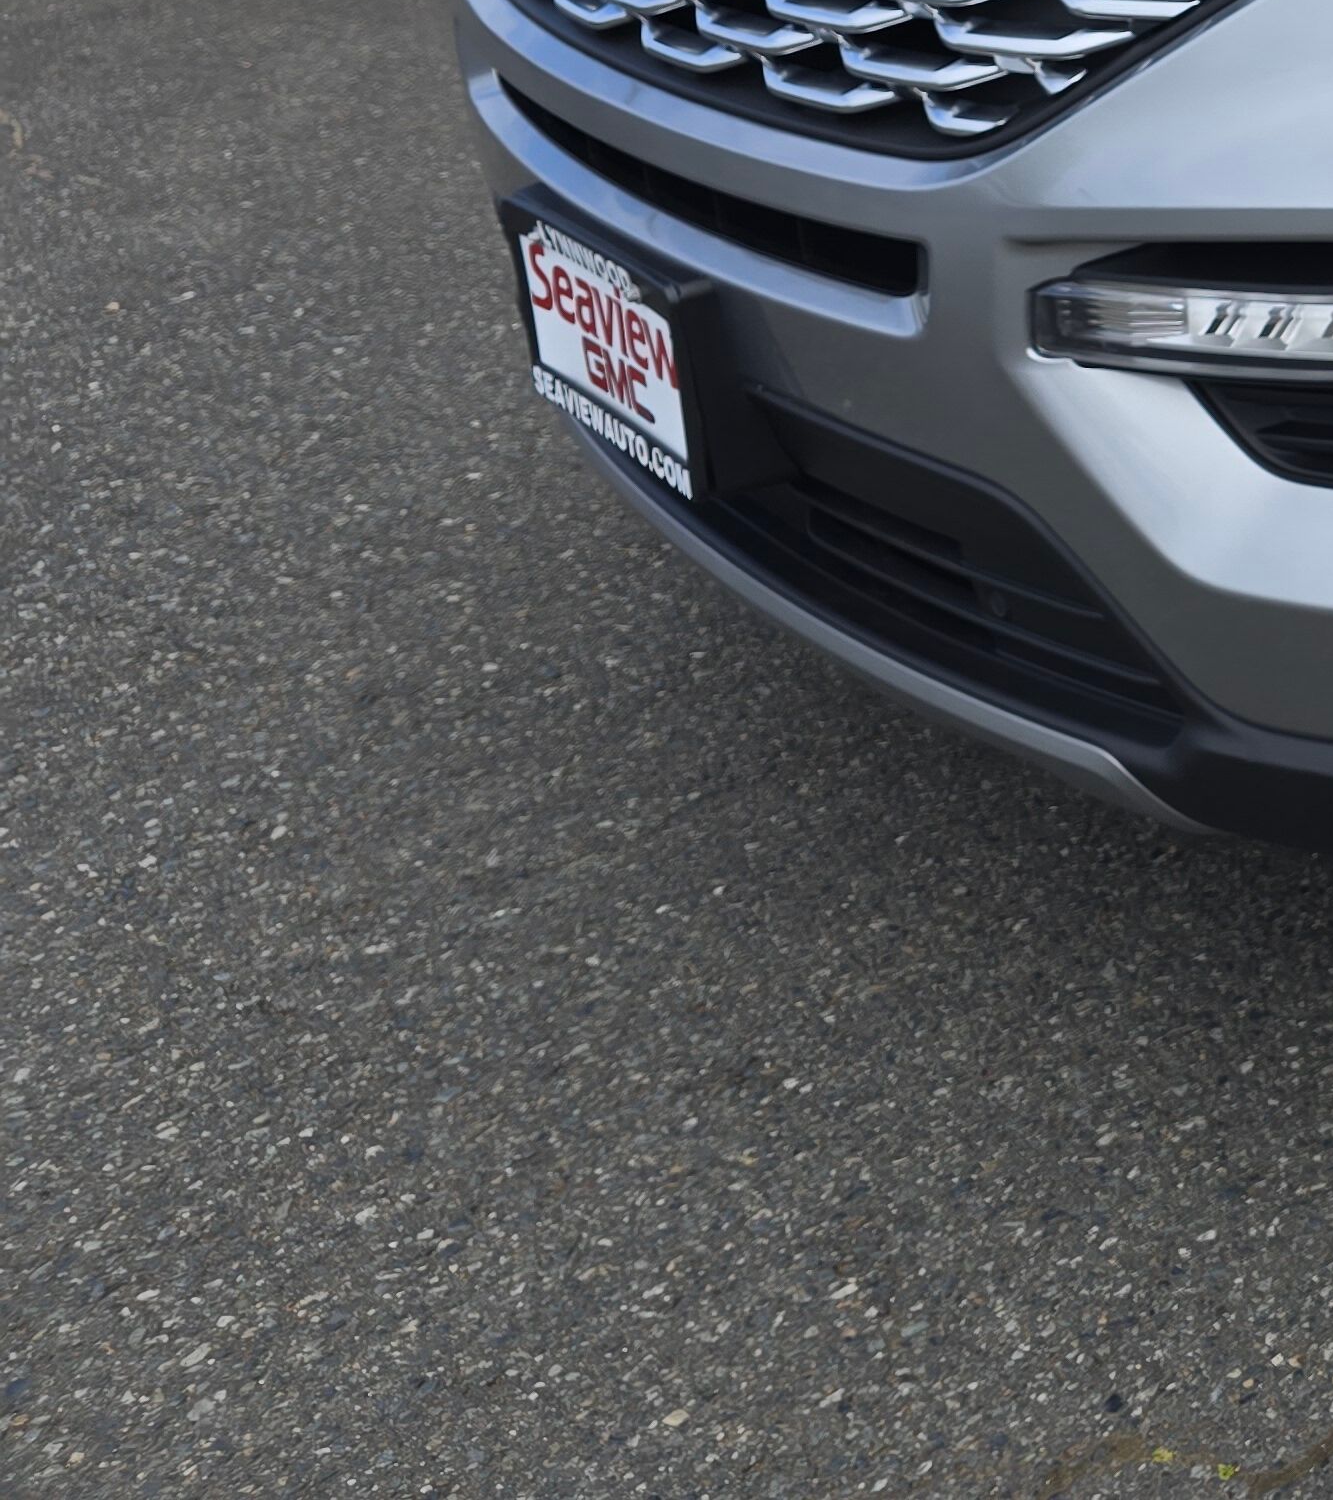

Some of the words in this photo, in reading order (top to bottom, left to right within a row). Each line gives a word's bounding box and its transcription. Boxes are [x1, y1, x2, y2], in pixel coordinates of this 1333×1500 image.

[535, 219, 633, 294] LYNNWOOD
[528, 243, 679, 390] Seaview
[531, 364, 693, 500] SEAVIEWAUTO.COM
[581, 336, 655, 424] GMC
